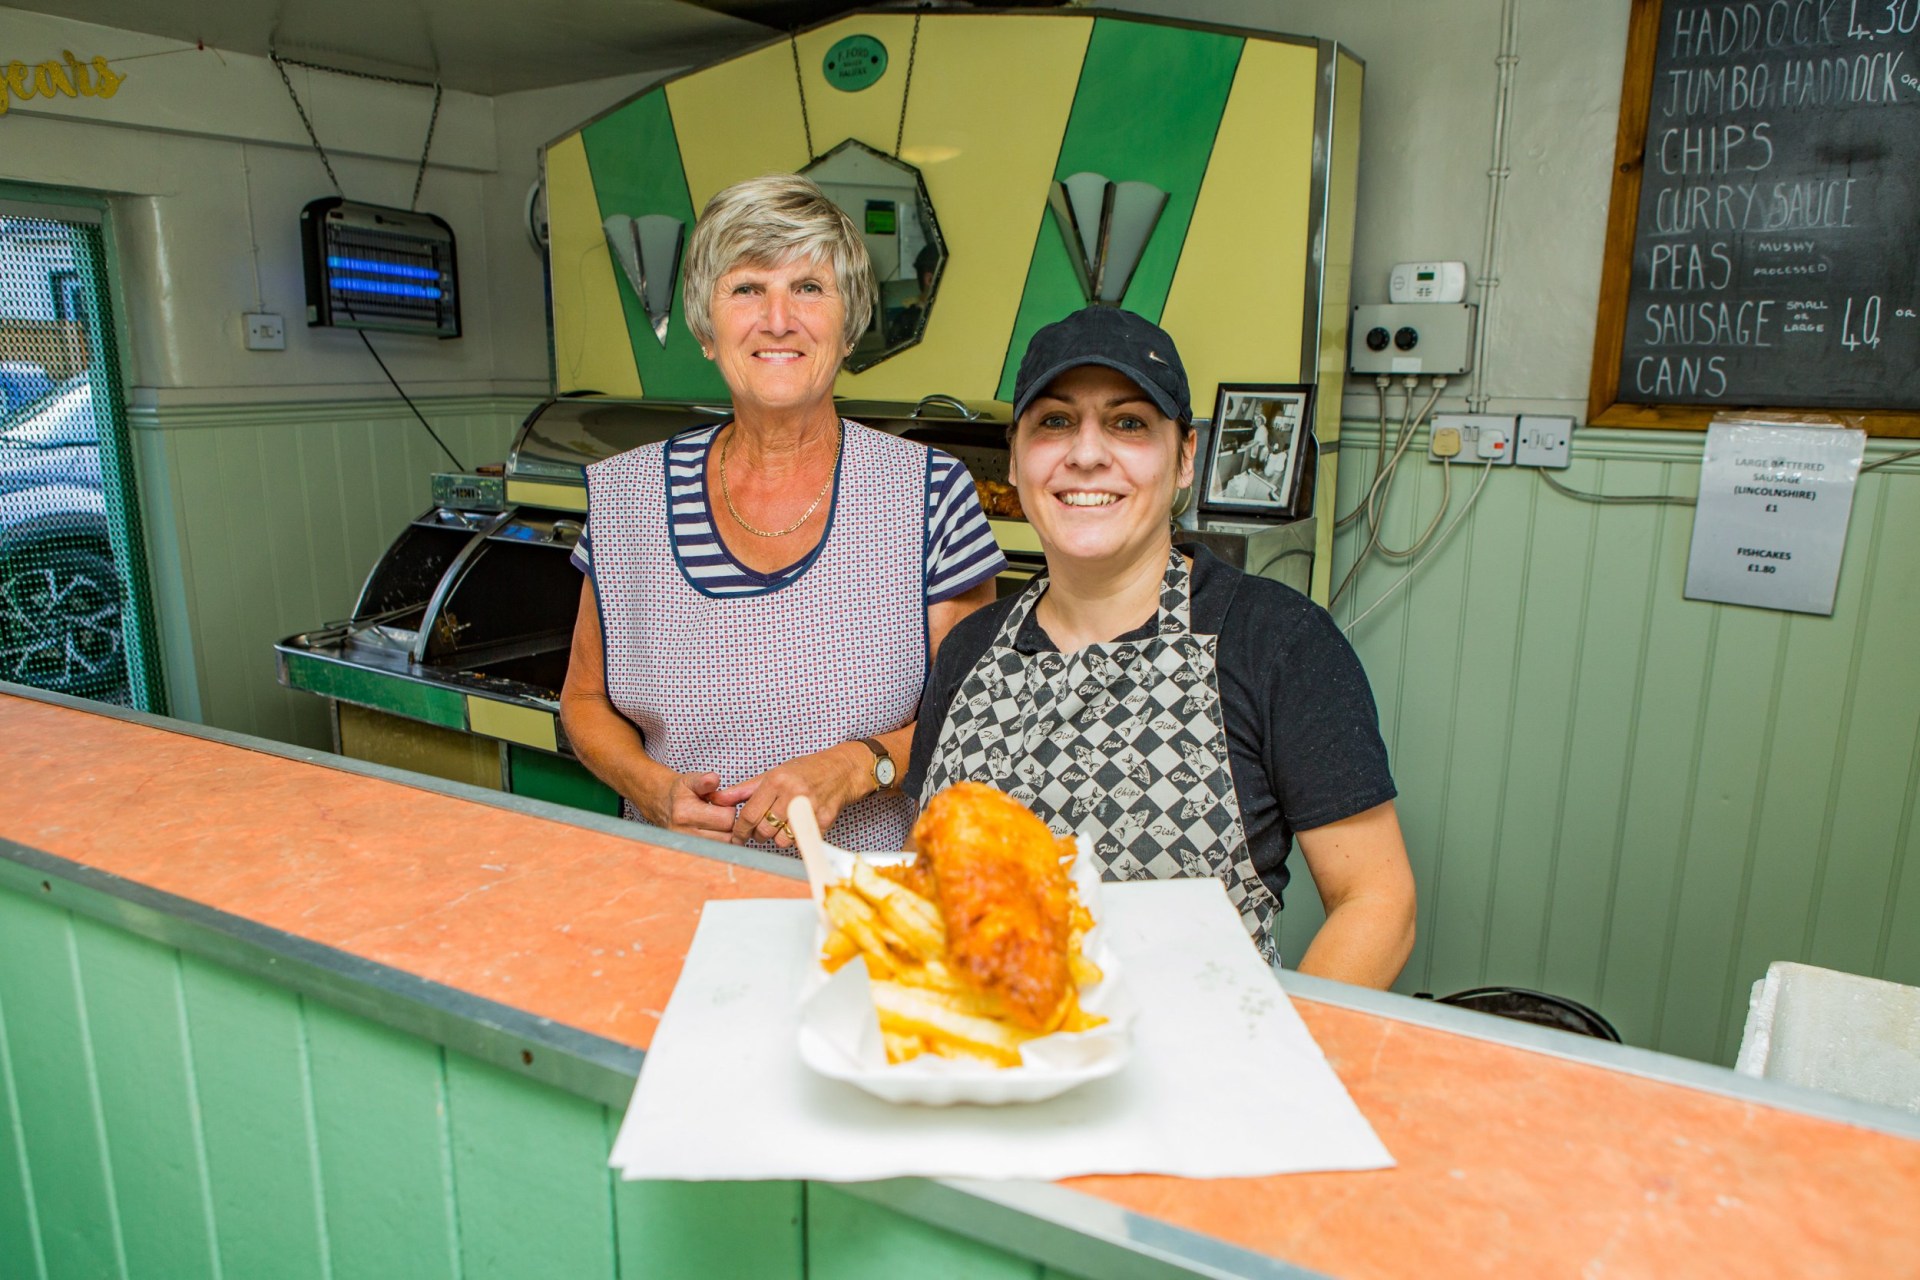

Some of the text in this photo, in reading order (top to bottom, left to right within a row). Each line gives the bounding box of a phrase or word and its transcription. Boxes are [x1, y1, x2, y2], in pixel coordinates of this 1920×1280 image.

[1671, 0, 1837, 58] HADDOCK
[1662, 63, 1770, 118] JUMBO
[1782, 50, 1904, 106] HADDOCK
[1660, 122, 1774, 176] CHIPS
[1656, 178, 1858, 234] CURRY SAUCE
[1649, 241, 1815, 291] PEAS MUSHY
[1753, 263, 1828, 277] PROCESSED
[1645, 300, 1776, 347] SAUSAGE
[1786, 300, 1829, 311] SMALL
[1895, 308, 1917, 318] OR
[1783, 323, 1825, 333] LARGE
[1636, 355, 1727, 398] CANS
[1735, 458, 1825, 472] LARGE BATTERED
[1753, 472, 1802, 485] SAUSAGE
[1733, 485, 1817, 502] (LINCOLNSHIRE)
[1765, 503, 1778, 513] £1
[1737, 547, 1792, 561] FISHCAKES
[1747, 563, 1777, 574] £1.80
[1116, 650, 1137, 662] Fish
[1041, 660, 1062, 671] Fish
[970, 697, 991, 708] Chips
[1155, 720, 1177, 731] Fish
[1054, 730, 1076, 742] Fish
[1102, 739, 1123, 752] Fish
[1061, 771, 1087, 783] Chips
[1171, 771, 1198, 784] Chips
[1011, 790, 1035, 801] Chips
[1113, 787, 1141, 799] Chips
[1152, 825, 1177, 837] Fish
[1098, 843, 1119, 855] Fish
[1208, 849, 1226, 861] Fish
